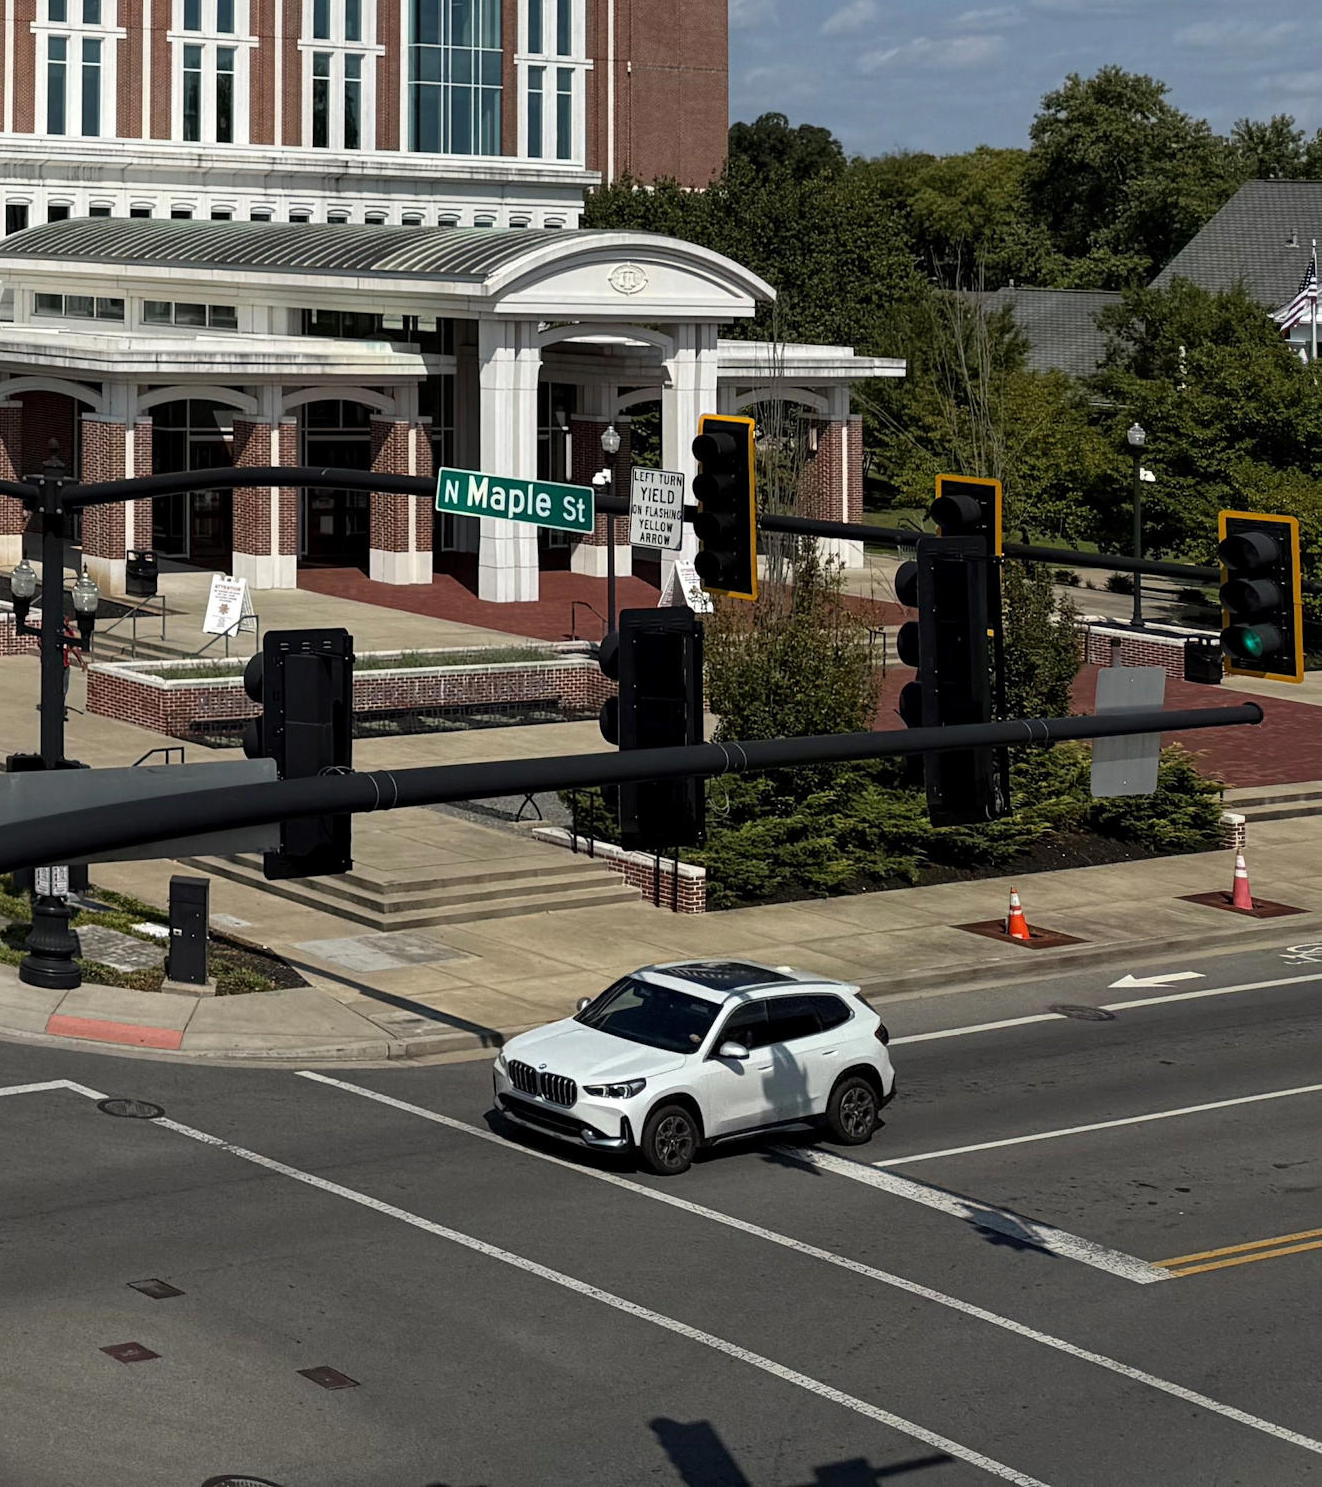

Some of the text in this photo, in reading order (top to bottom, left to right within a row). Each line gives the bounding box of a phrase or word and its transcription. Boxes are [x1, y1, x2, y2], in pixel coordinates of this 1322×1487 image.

[634, 470, 683, 487] LEFT TURN
[444, 475, 586, 523] N Maple St
[640, 486, 675, 504] YIELD
[632, 504, 683, 521] ON FLASHING
[639, 519, 673, 533] YELLOW
[639, 532, 671, 546] ARROW
